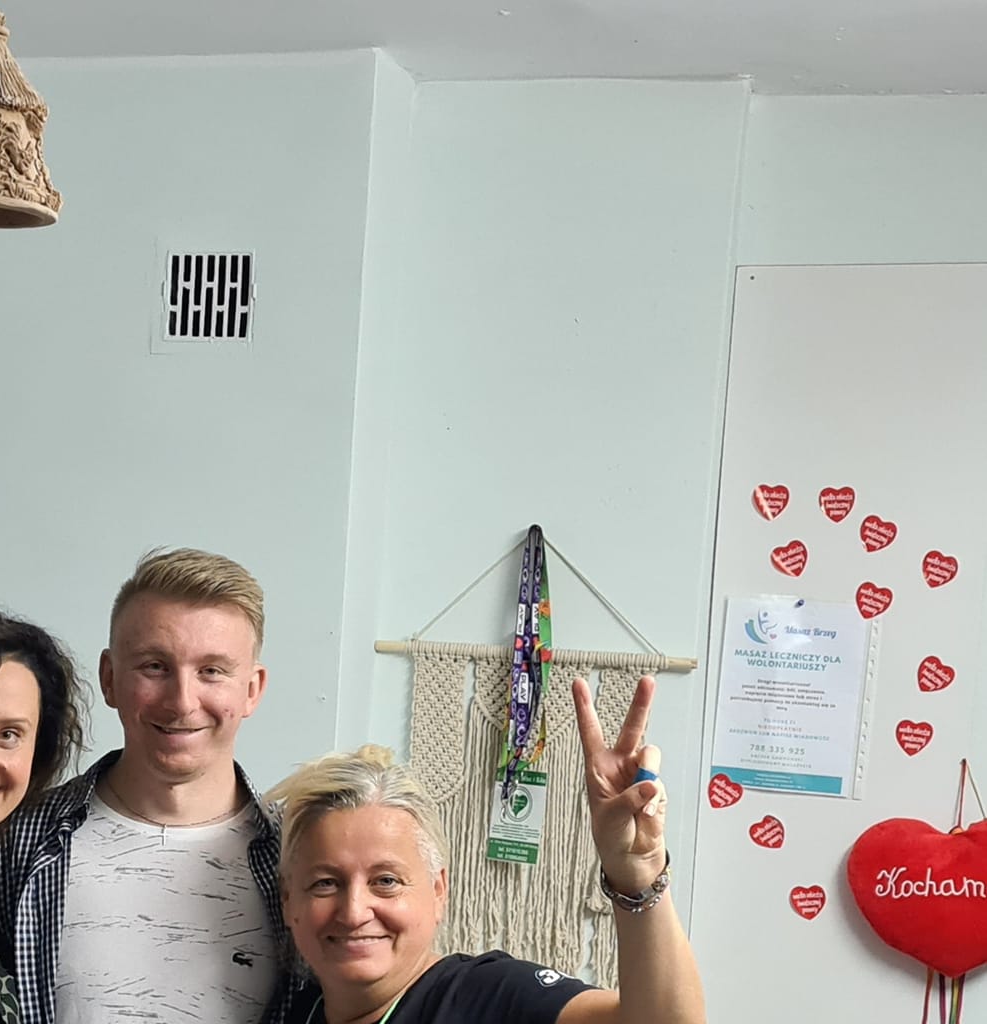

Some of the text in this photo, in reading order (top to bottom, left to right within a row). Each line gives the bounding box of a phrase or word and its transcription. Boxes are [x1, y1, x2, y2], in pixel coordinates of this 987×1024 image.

[517, 605, 525, 633] PLAY
[747, 658, 827, 671] WOLONTARIUSZY
[770, 651, 822, 662] LECZNICZY
[823, 655, 841, 664] DLA
[874, 865, 987, 899] Kocham
